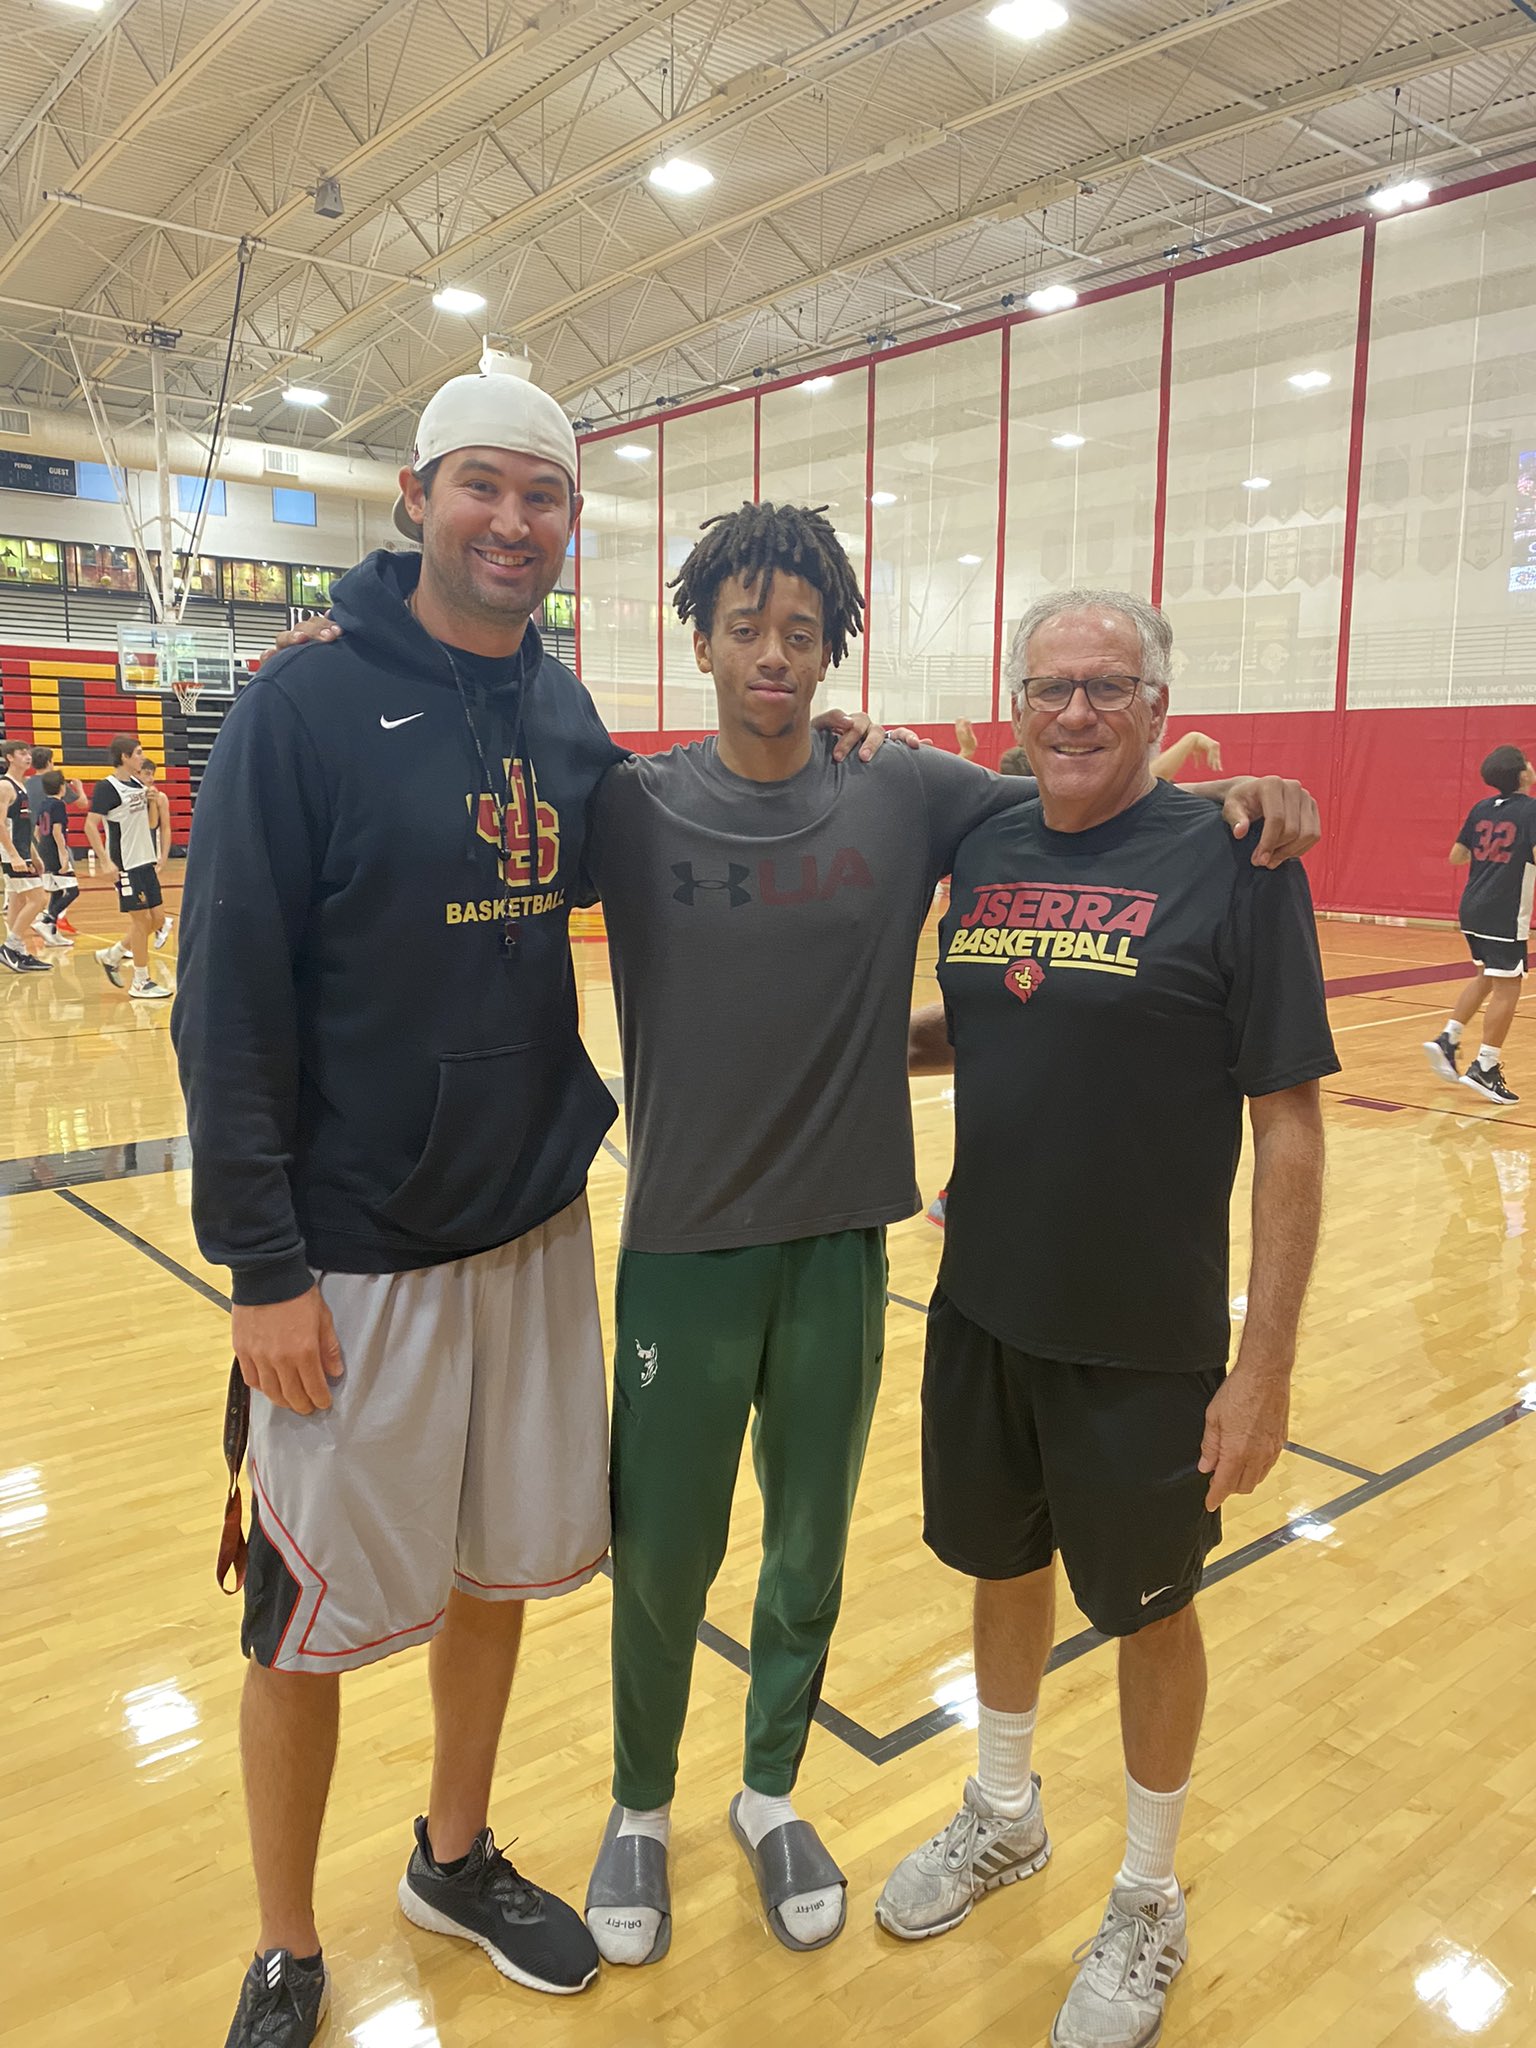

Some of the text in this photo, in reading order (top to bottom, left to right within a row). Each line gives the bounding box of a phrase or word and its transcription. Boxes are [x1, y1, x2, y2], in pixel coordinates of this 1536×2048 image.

[14, 462, 32, 470] PERIOD
[48, 466, 69, 476] GUEST
[1473, 820, 1517, 864] 32
[757, 847, 875, 906] UA
[446, 888, 565, 924] BASKETBALL
[960, 890, 1156, 937] JSERRA
[948, 928, 1140, 967] BASKETBALL
[605, 1918, 642, 1930] DRI-FIT
[795, 1899, 825, 1915] DRI-FIT
